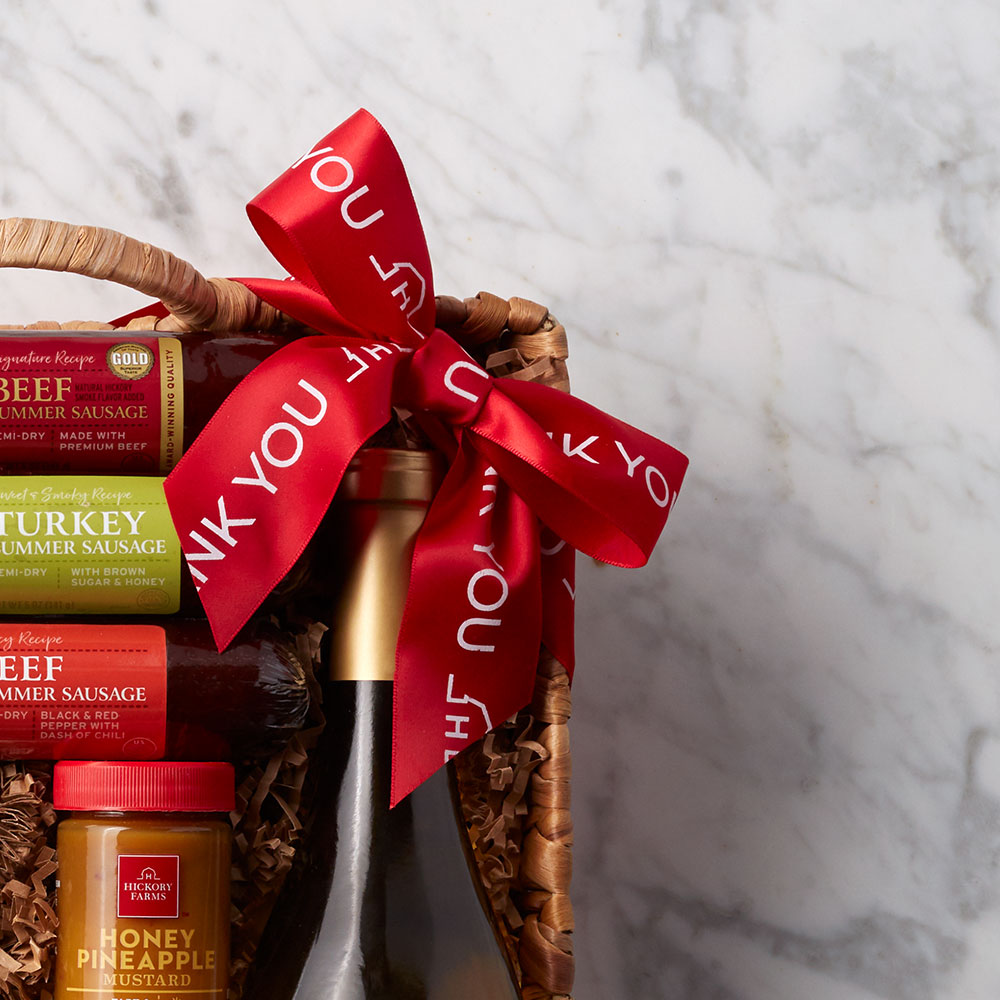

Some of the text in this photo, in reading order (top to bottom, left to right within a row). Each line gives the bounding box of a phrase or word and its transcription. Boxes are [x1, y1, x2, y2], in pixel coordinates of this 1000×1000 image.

[55, 350, 95, 370] Recipe
[112, 352, 149, 365] GOLD
[166, 350, 175, 390] QUALITY
[71, 405, 148, 419] SAUSAGE
[60, 432, 126, 440] MADE WITH
[231, 379, 328, 495] YOU
[60, 443, 148, 451] PREMIUM BEEF
[93, 487, 133, 505] Recipe
[82, 540, 167, 555] SAUSAGE
[71, 568, 146, 576] WITH BROWN
[71, 578, 166, 586] SUGAR & HONEY
[18, 631, 64, 651] Recipe
[62, 687, 146, 701] SAUSAGE
[41, 711, 119, 720] BLACK & RED
[41, 721, 119, 730] PEPPER WITH
[94, 731, 125, 739] CHILI
[124, 883, 172, 892] HICKORY
[131, 892, 166, 901] FARMS
[101, 928, 195, 949] HONEY
[78, 949, 215, 970] PINEAPPLE
[104, 974, 191, 987] MUSTARD
